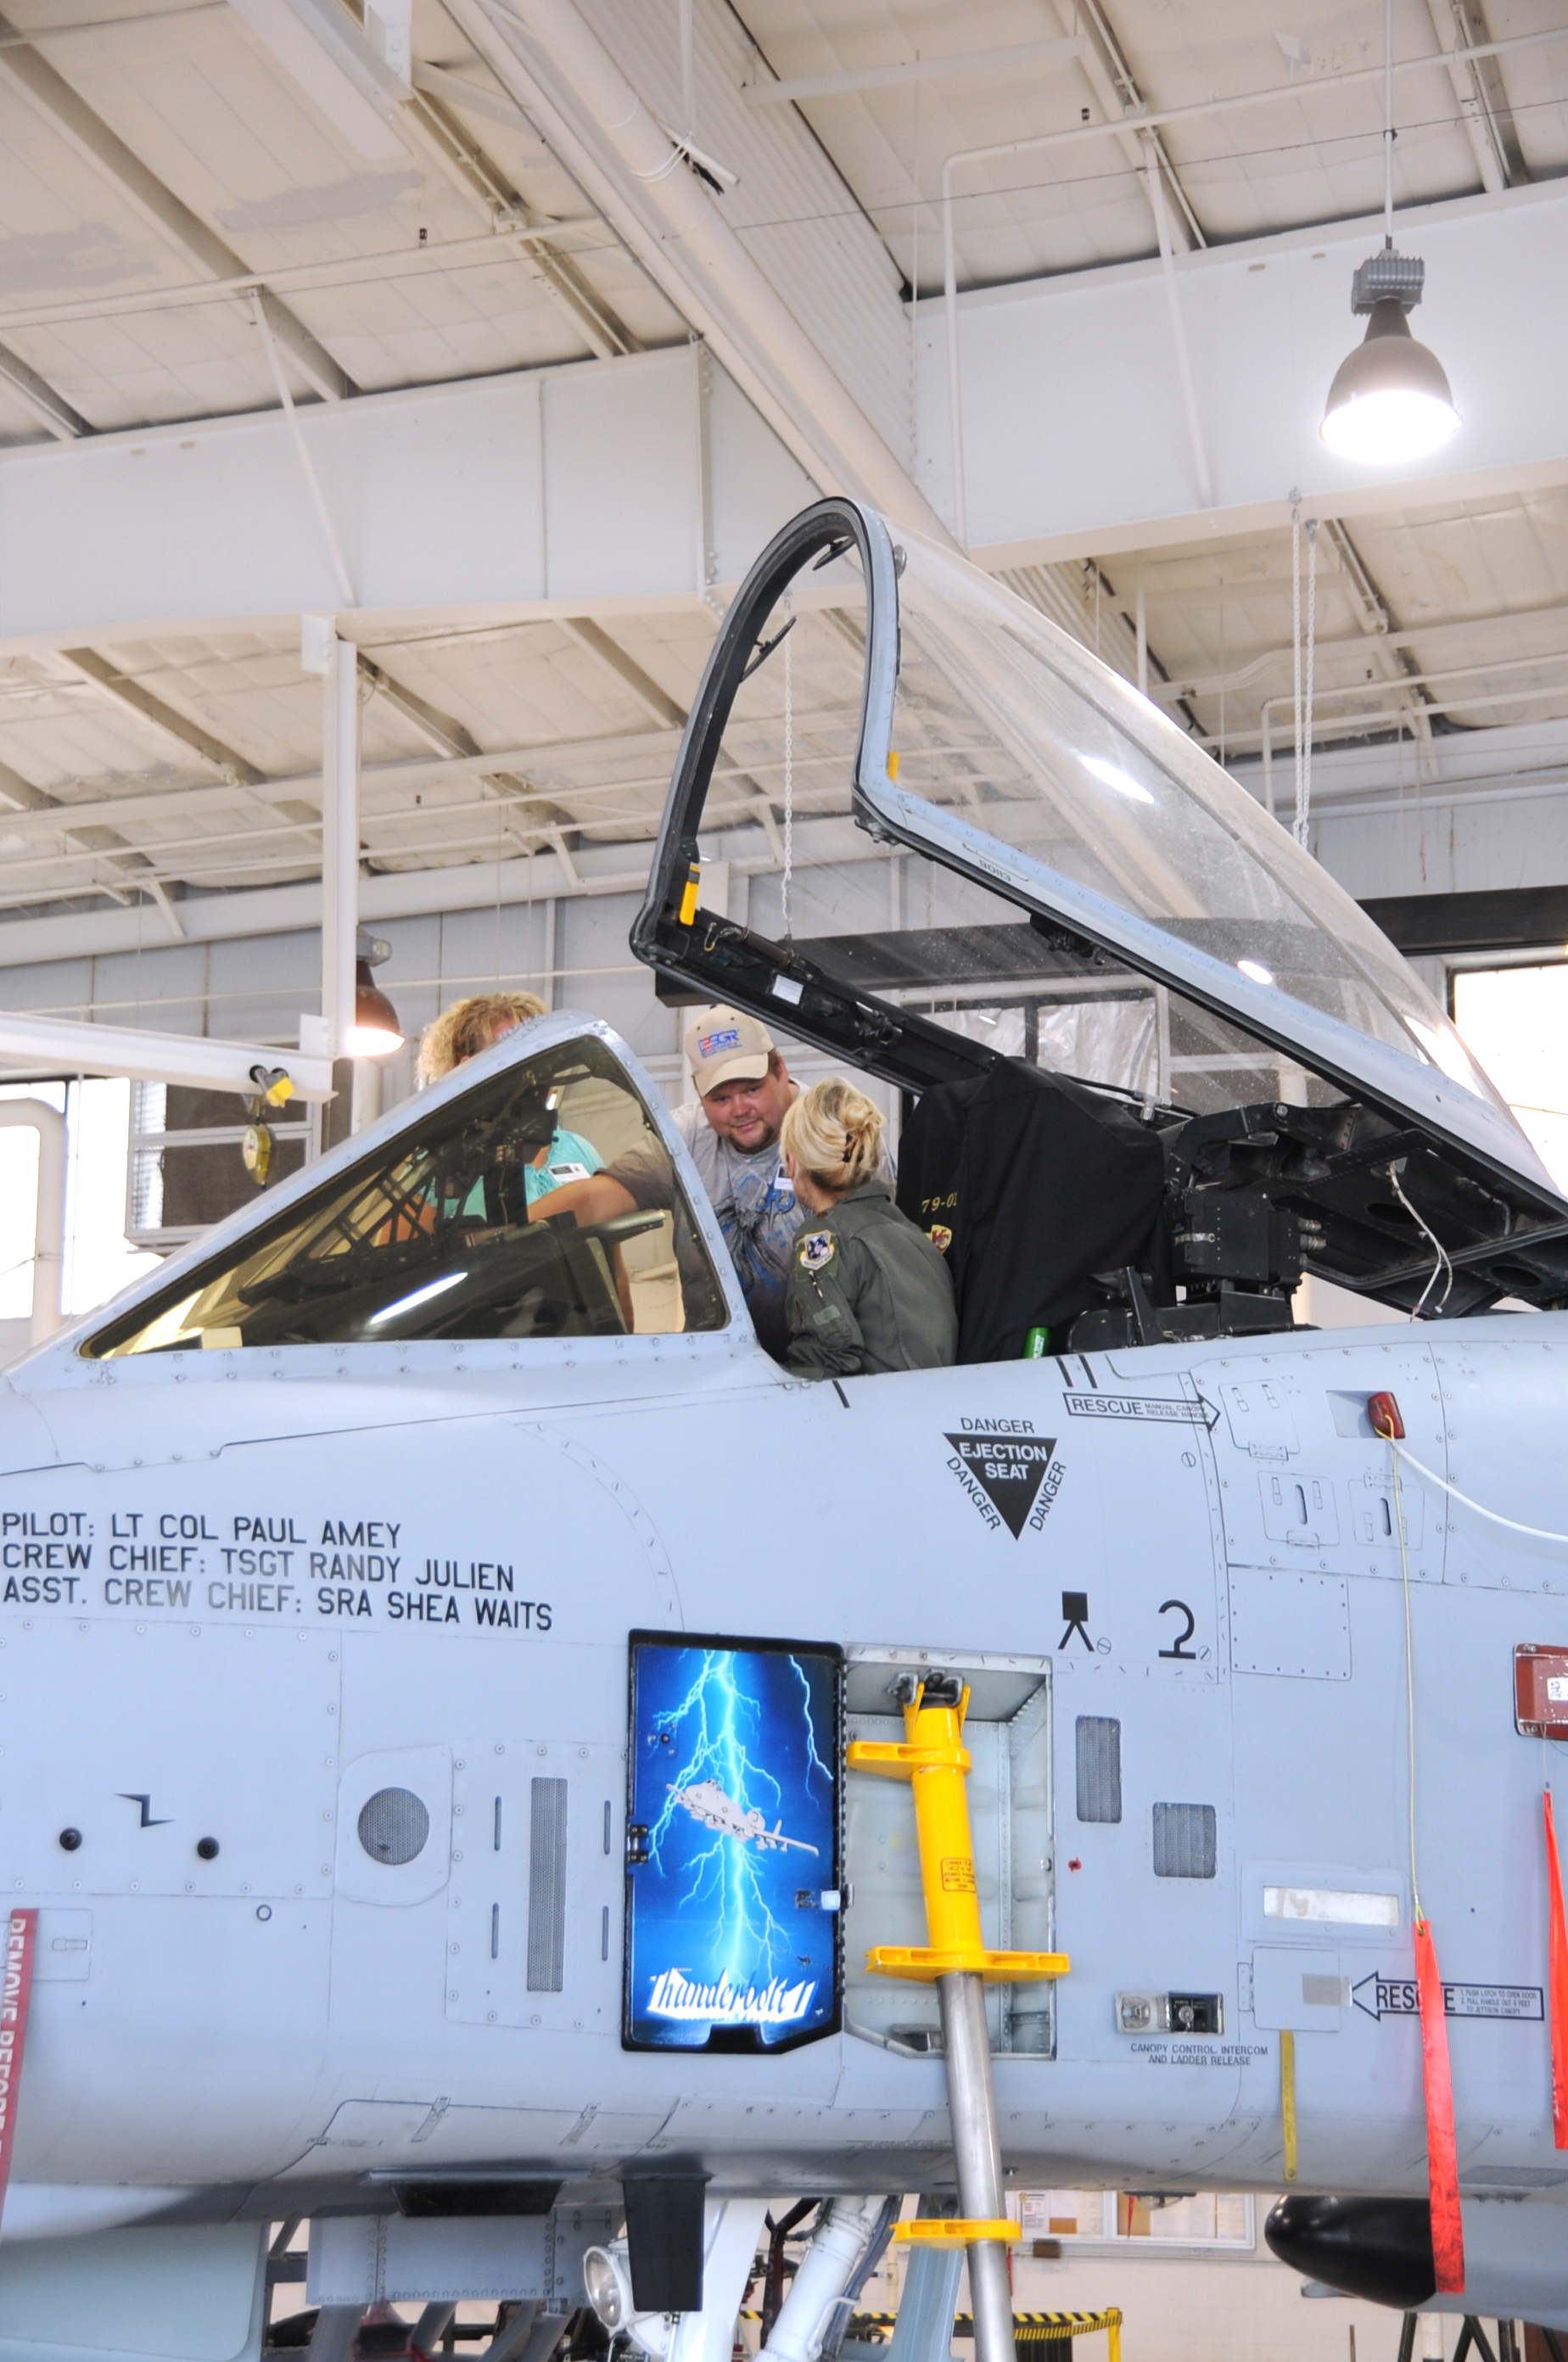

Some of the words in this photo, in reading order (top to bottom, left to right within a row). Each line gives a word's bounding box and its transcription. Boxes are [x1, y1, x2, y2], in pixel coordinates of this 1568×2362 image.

[1071, 1398, 1144, 1415] RESCUE
[960, 1418, 1035, 1433] DANGER
[959, 1442, 1048, 1461] EJECTION
[984, 1463, 1029, 1480] SEAT
[946, 1457, 1001, 1531] DANGER
[1029, 1461, 1067, 1531] DANGER
[2, 1512, 95, 1536] PILOT:
[112, 1514, 143, 1537] LT
[160, 1514, 219, 1540] COL
[233, 1516, 307, 1543] PAUL
[321, 1520, 401, 1548] AMEY
[3, 1543, 92, 1570] CREW
[109, 1545, 205, 1573] CHIEF:
[221, 1548, 294, 1577] TSGT
[310, 1552, 401, 1583] RANDY
[415, 1559, 514, 1592] JULIEN
[3, 1576, 87, 1604] ASST.
[104, 1578, 192, 1607] CREW
[208, 1581, 301, 1614] CHIEF:
[317, 1587, 372, 1616] SRA
[388, 1591, 460, 1623] SHEA
[474, 1597, 552, 1631] WAITS
[647, 1967, 790, 2022] Thunderbolt
[1376, 1984, 1456, 2011] RESE
[1130, 2043, 1168, 2053] CANOPY
[1221, 2046, 1268, 2055] INTERCOM
[1148, 2055, 1168, 2064] AND
[1171, 2055, 1207, 2065] LADDER
[1211, 2057, 1251, 2065] RELEASE
